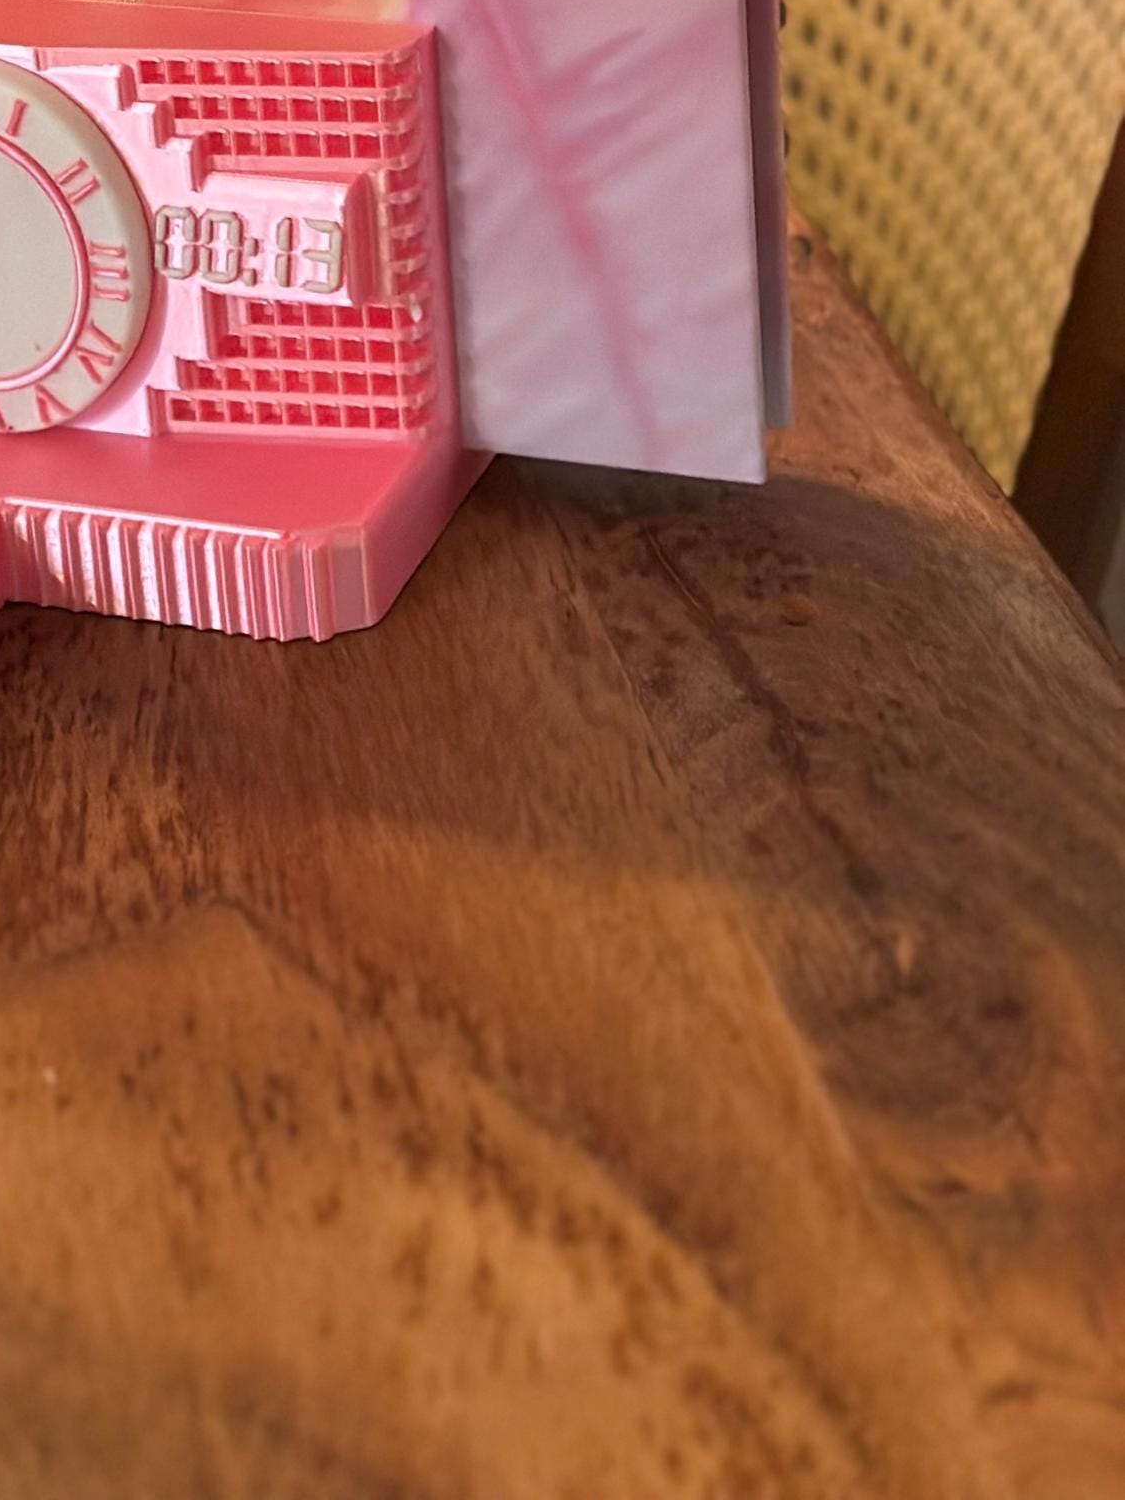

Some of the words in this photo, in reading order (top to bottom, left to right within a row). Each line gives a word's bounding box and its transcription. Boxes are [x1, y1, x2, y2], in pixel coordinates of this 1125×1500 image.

[6, 99, 28, 137] I
[57, 158, 100, 201] II
[89, 242, 130, 301] III
[154, 205, 342, 294] 00:13
[76, 319, 122, 384] IV
[35, 384, 75, 424] V
